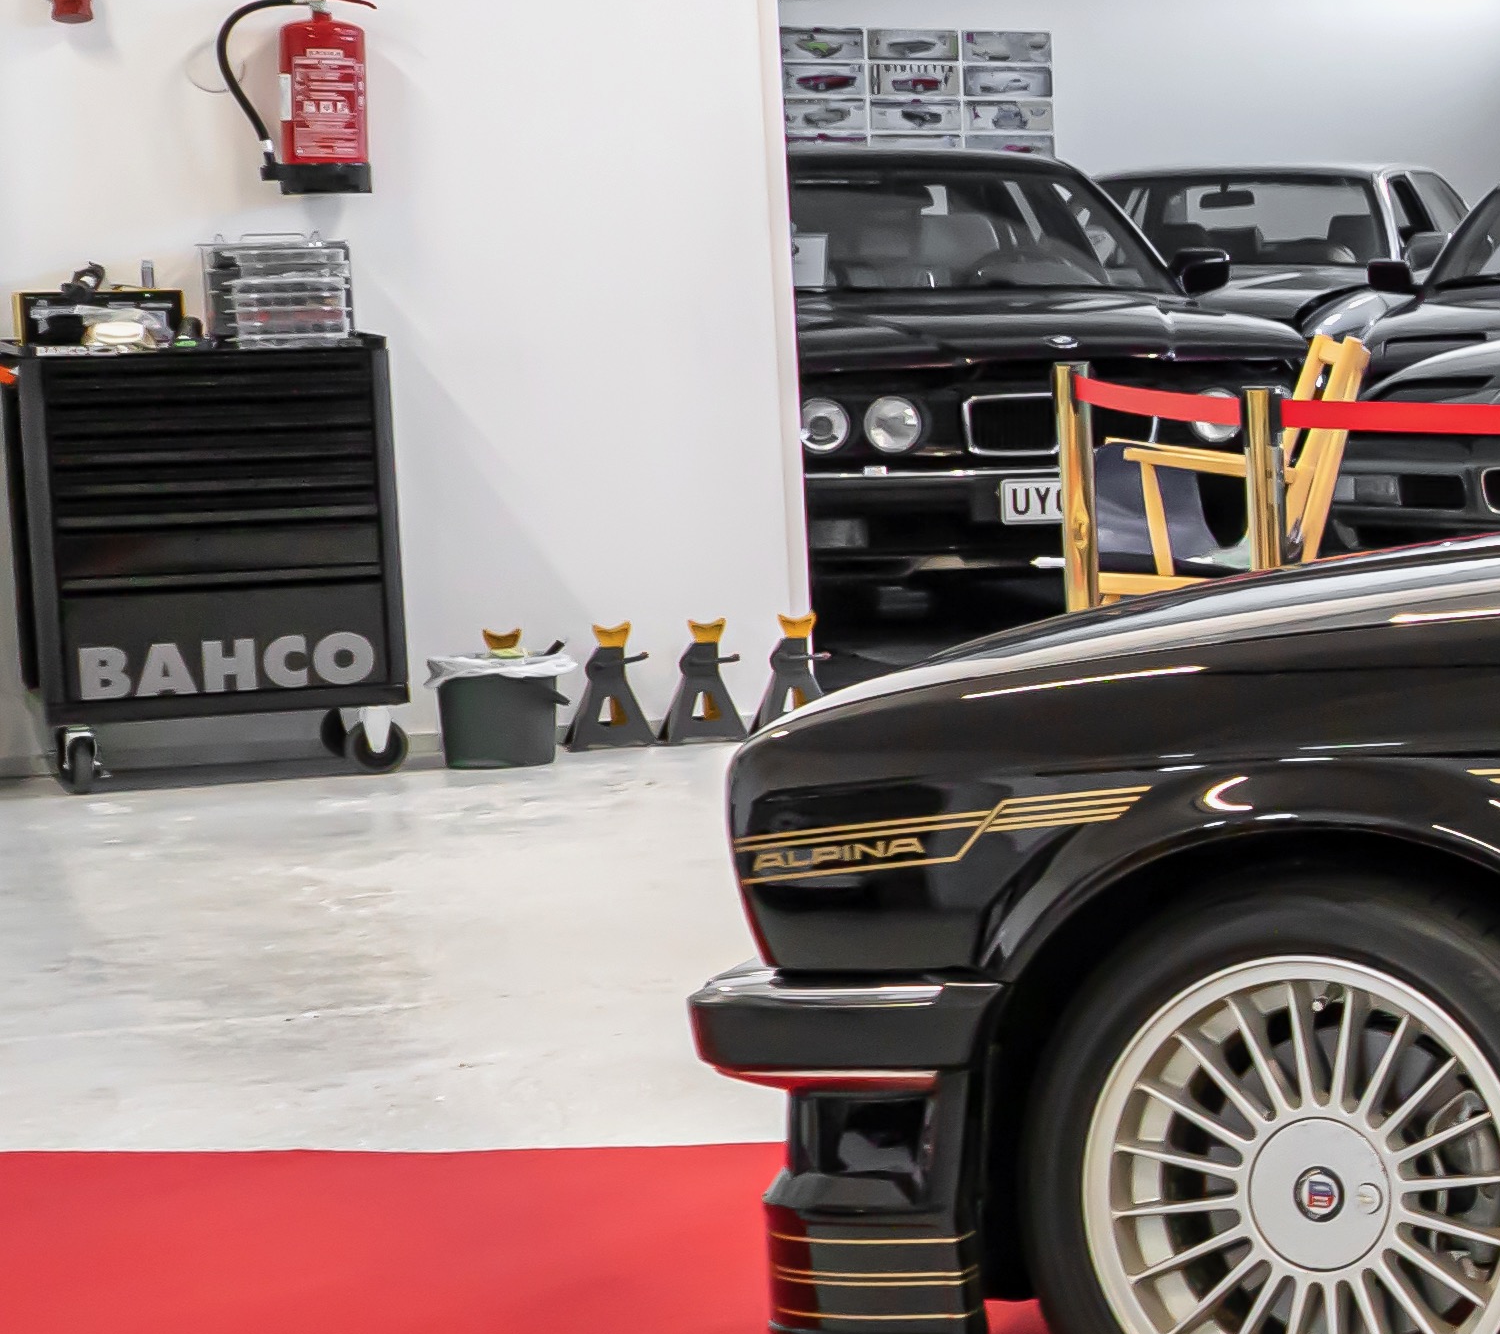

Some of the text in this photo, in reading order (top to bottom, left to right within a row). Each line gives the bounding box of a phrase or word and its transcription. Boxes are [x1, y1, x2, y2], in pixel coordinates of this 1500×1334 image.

[1011, 487, 1062, 516] UY
[78, 631, 375, 701] BAHCO
[752, 837, 927, 872] ALPINA
